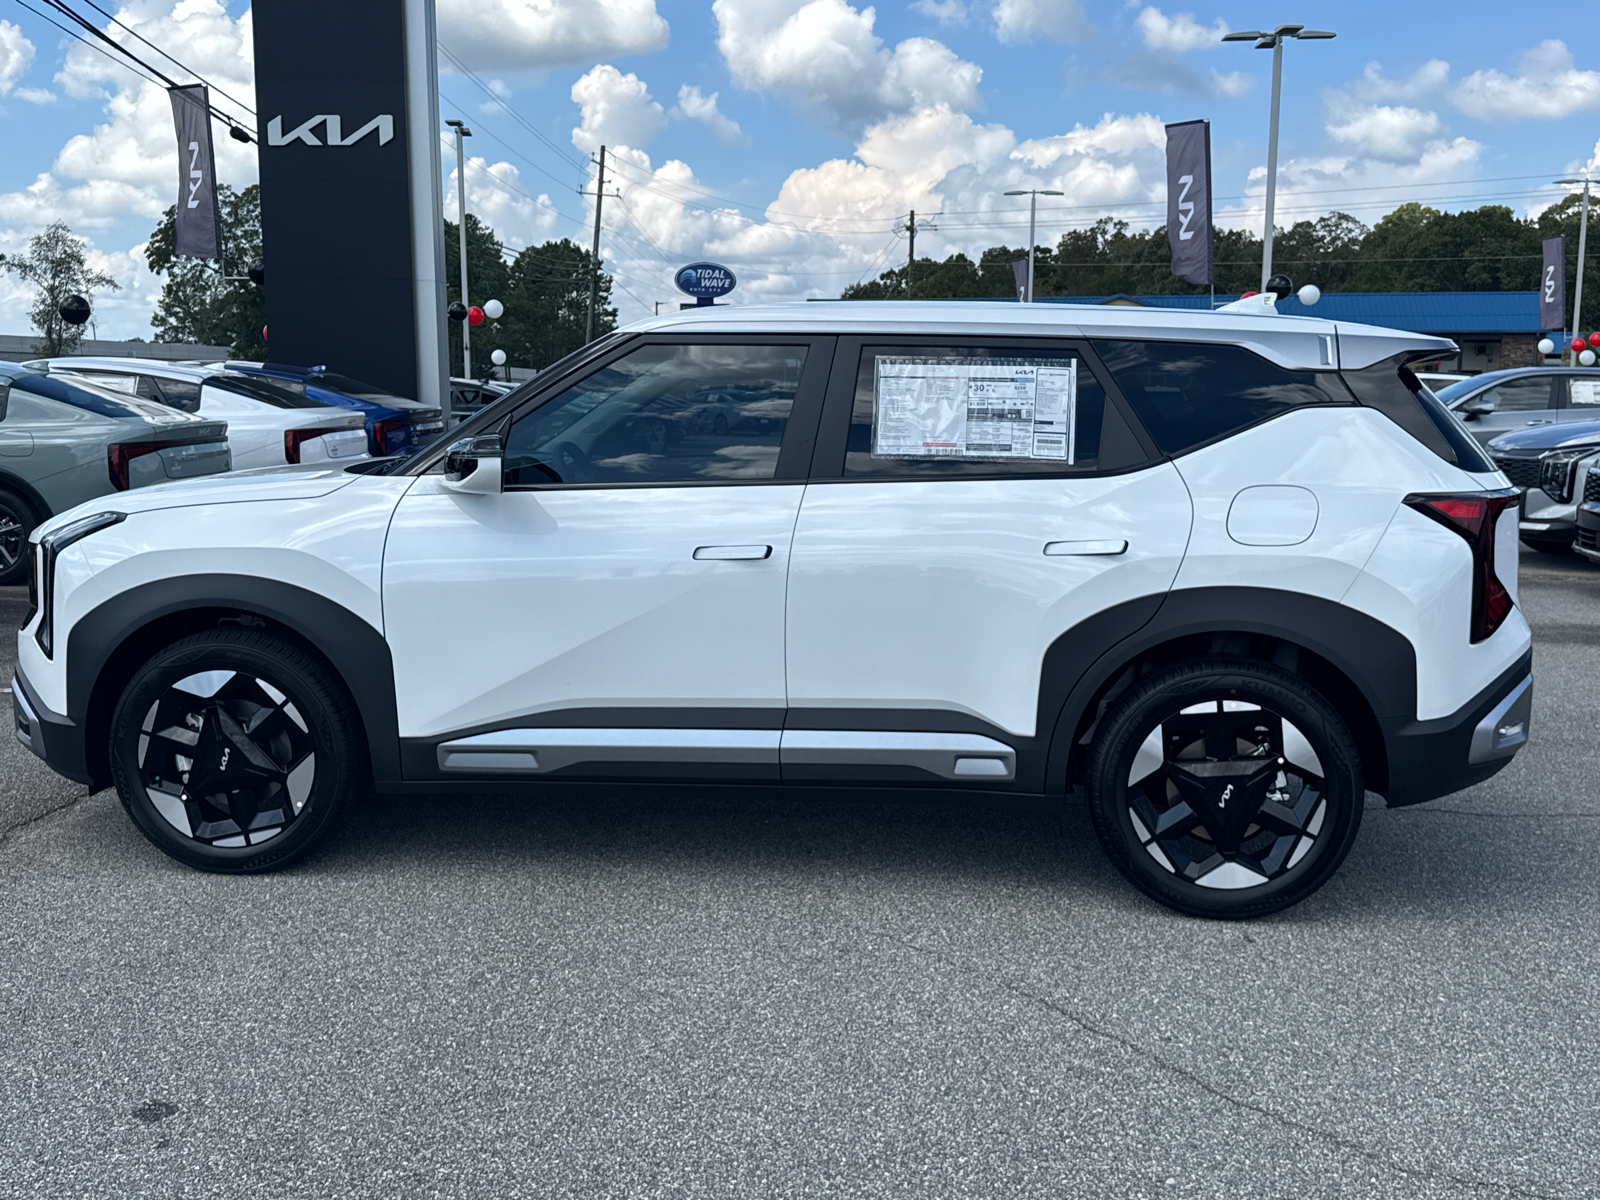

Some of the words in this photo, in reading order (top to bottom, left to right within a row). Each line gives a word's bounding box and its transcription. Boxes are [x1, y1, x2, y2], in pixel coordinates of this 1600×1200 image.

[267, 114, 394, 147] KIA
[187, 141, 203, 209] KIA
[1177, 174, 1195, 241] KIA
[696, 269, 726, 278] TIDAL
[701, 278, 731, 288] WAVE
[973, 383, 985, 392] 30
[1241, 679, 1308, 713] KUMHO
